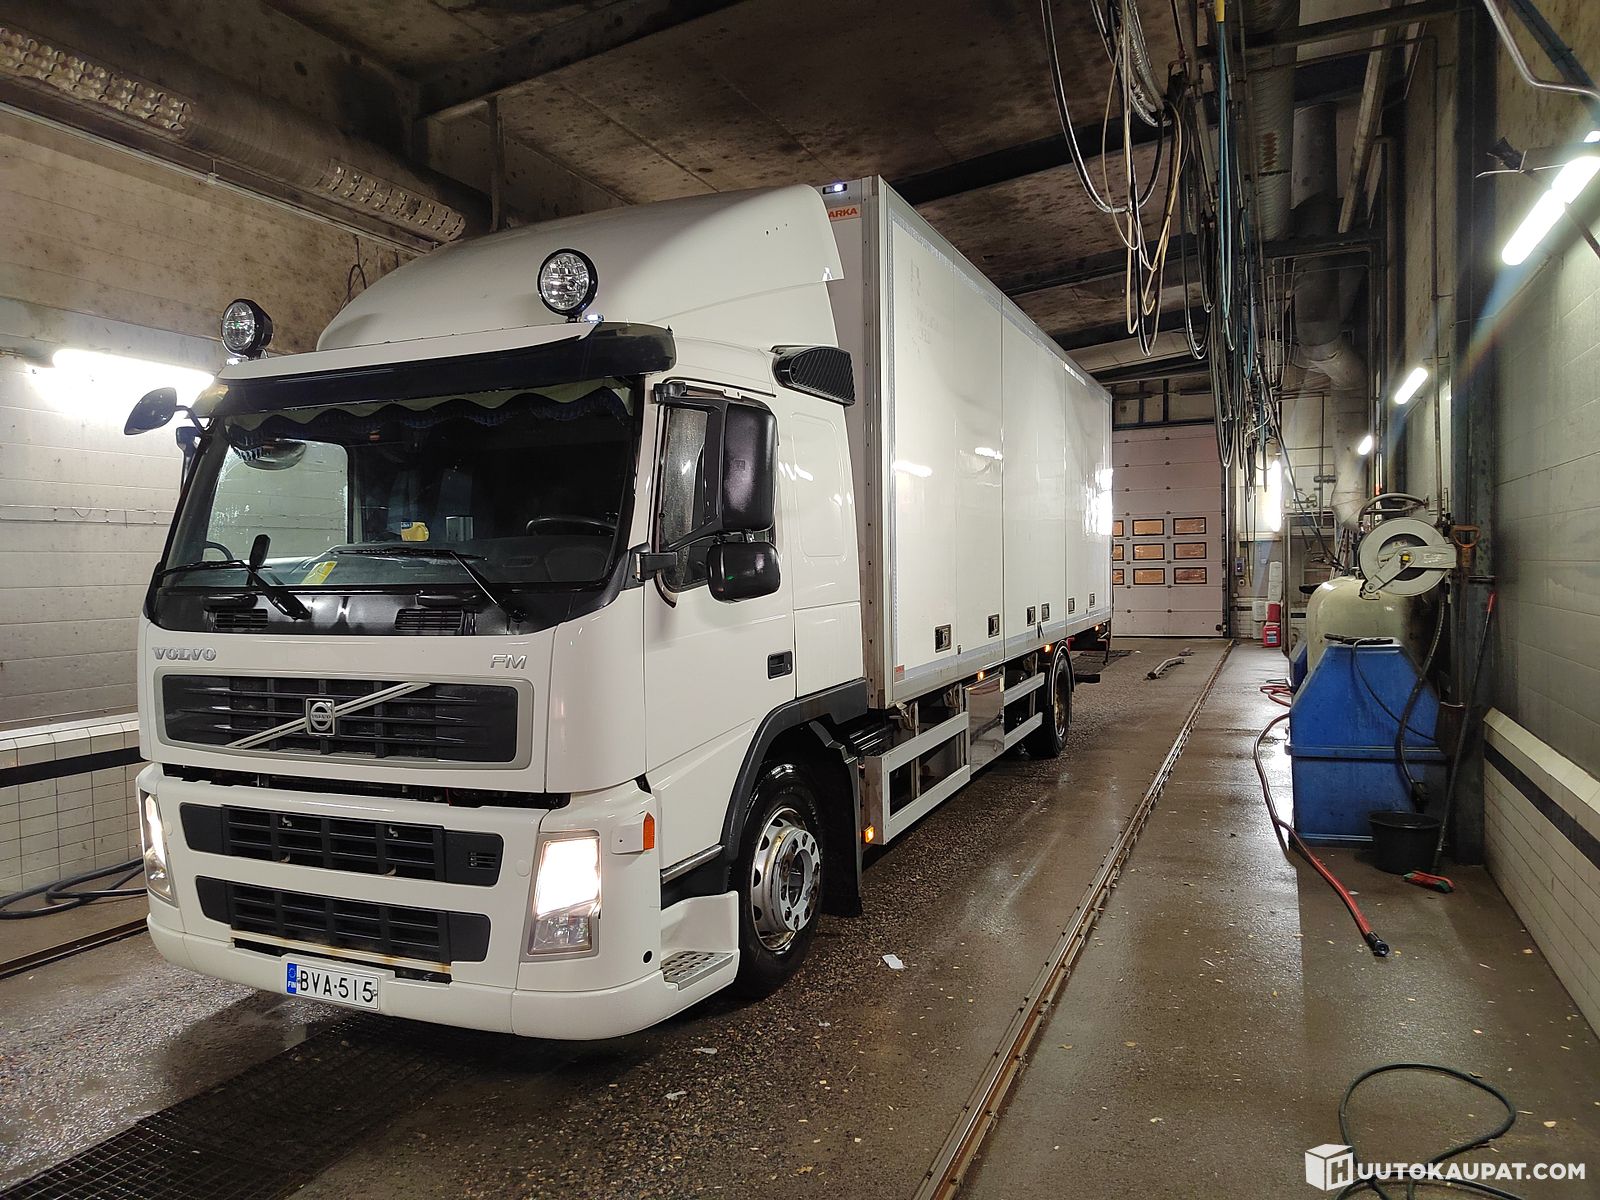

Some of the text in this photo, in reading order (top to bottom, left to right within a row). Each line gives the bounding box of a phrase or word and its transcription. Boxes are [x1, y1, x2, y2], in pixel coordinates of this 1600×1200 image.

[152, 647, 216, 661] VOLVO
[490, 654, 527, 669] FM
[300, 970, 374, 1003] BVA-515
